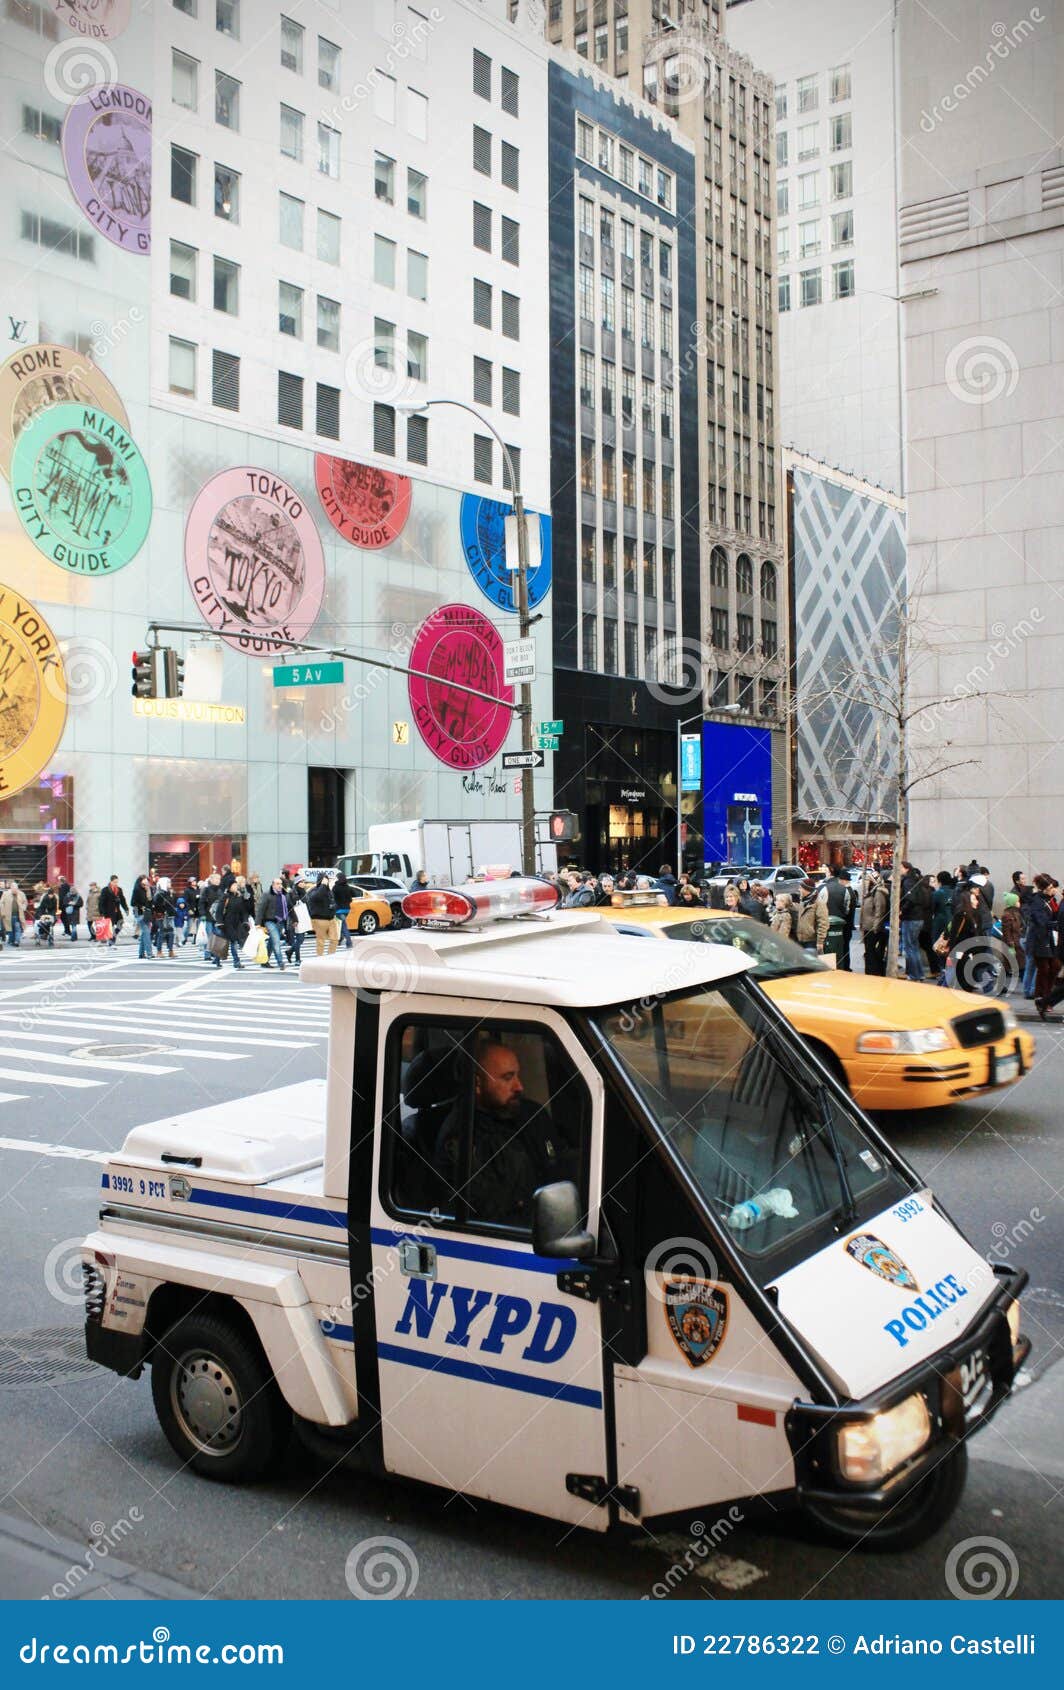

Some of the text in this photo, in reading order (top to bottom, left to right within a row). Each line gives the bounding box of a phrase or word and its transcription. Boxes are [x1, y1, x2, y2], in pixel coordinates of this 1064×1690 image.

[68, 14, 109, 38] GUIDE
[86, 198, 129, 242] CITY
[10, 350, 63, 381] ROME
[82, 410, 137, 461] MIAMI
[246, 472, 302, 520] TOKYO
[320, 486, 391, 545] CITY GUIDE
[16, 487, 111, 572] CITY GUIDE
[224, 548, 283, 615] TOKYO
[466, 544, 495, 591] CITY
[193, 575, 234, 631] CITY
[12, 601, 60, 673] YORK
[443, 611, 499, 651] MUMBAI
[292, 669, 299, 682] 5
[133, 700, 245, 723] LOUIS VUITTON
[416, 704, 493, 765] CITY GUIDE
[543, 723, 550, 734] 5
[543, 738, 552, 748] 57
[112, 1175, 166, 1198] 3992 9 PCT
[892, 1198, 925, 1223] 3992
[395, 1278, 577, 1364] NYPD
[883, 1274, 968, 1347] POLICE
